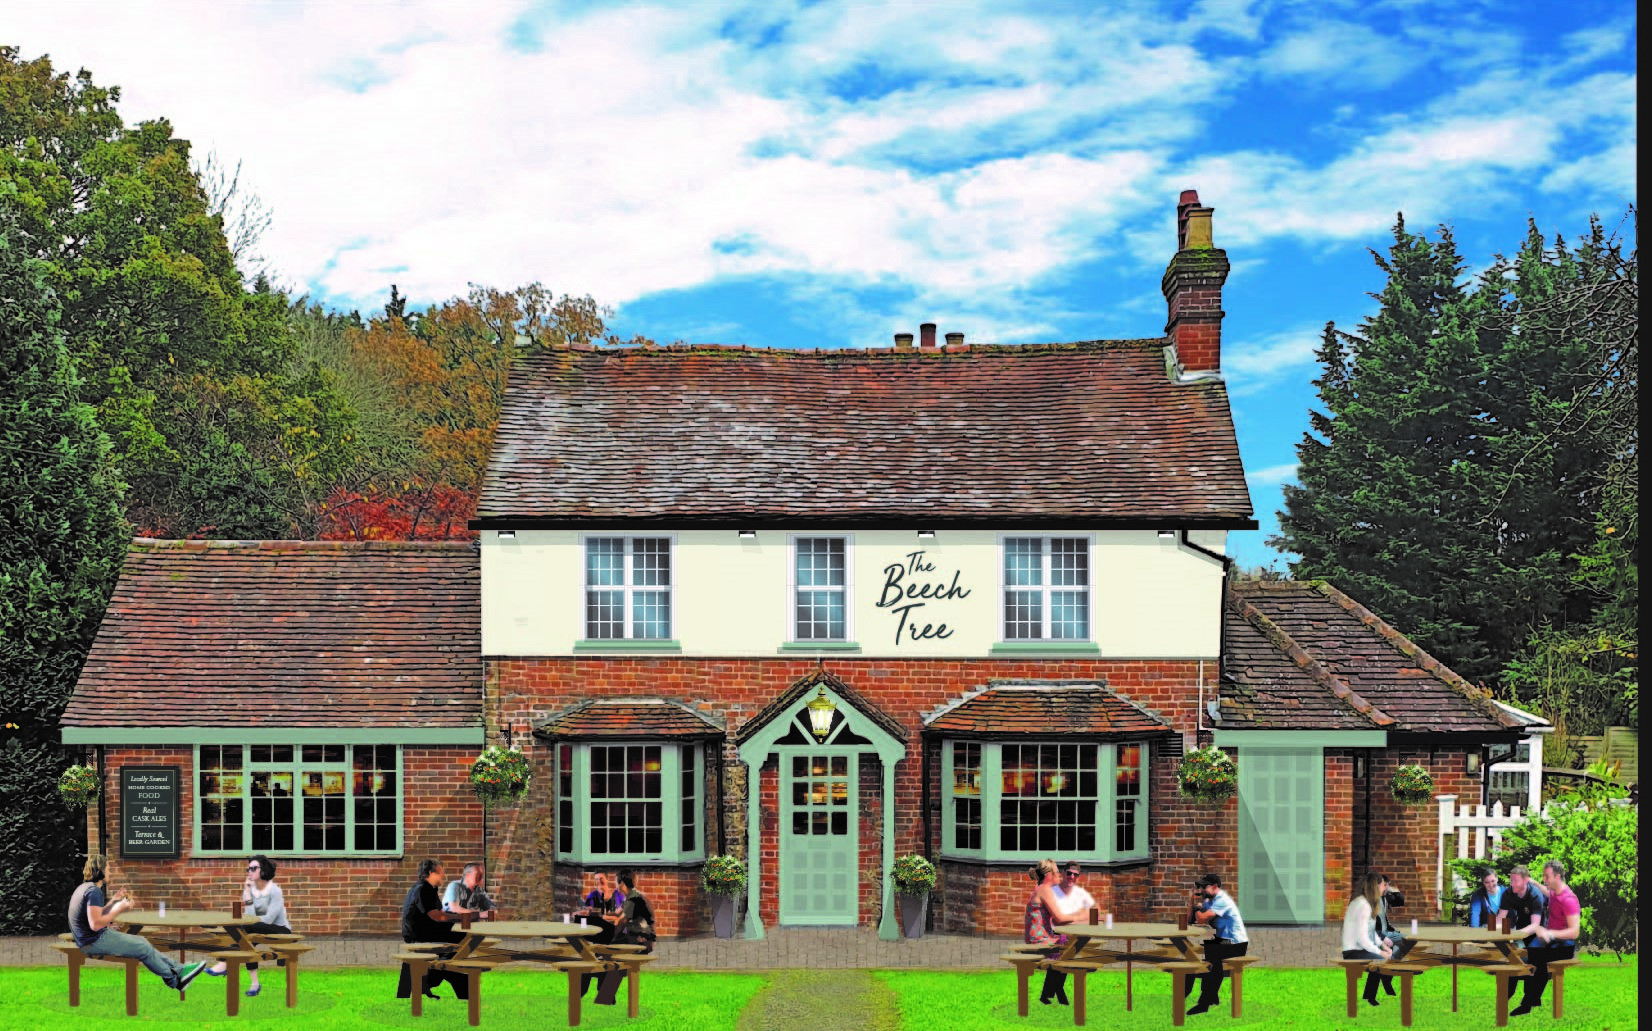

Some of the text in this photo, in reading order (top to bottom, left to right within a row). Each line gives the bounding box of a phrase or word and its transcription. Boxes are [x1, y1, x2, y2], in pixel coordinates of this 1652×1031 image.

[906, 550, 937, 576] The
[875, 563, 972, 608] Beech
[891, 602, 954, 646] Tree
[130, 775, 148, 783] Locally
[142, 806, 157, 814] Real
[134, 830, 156, 838] Terrace
